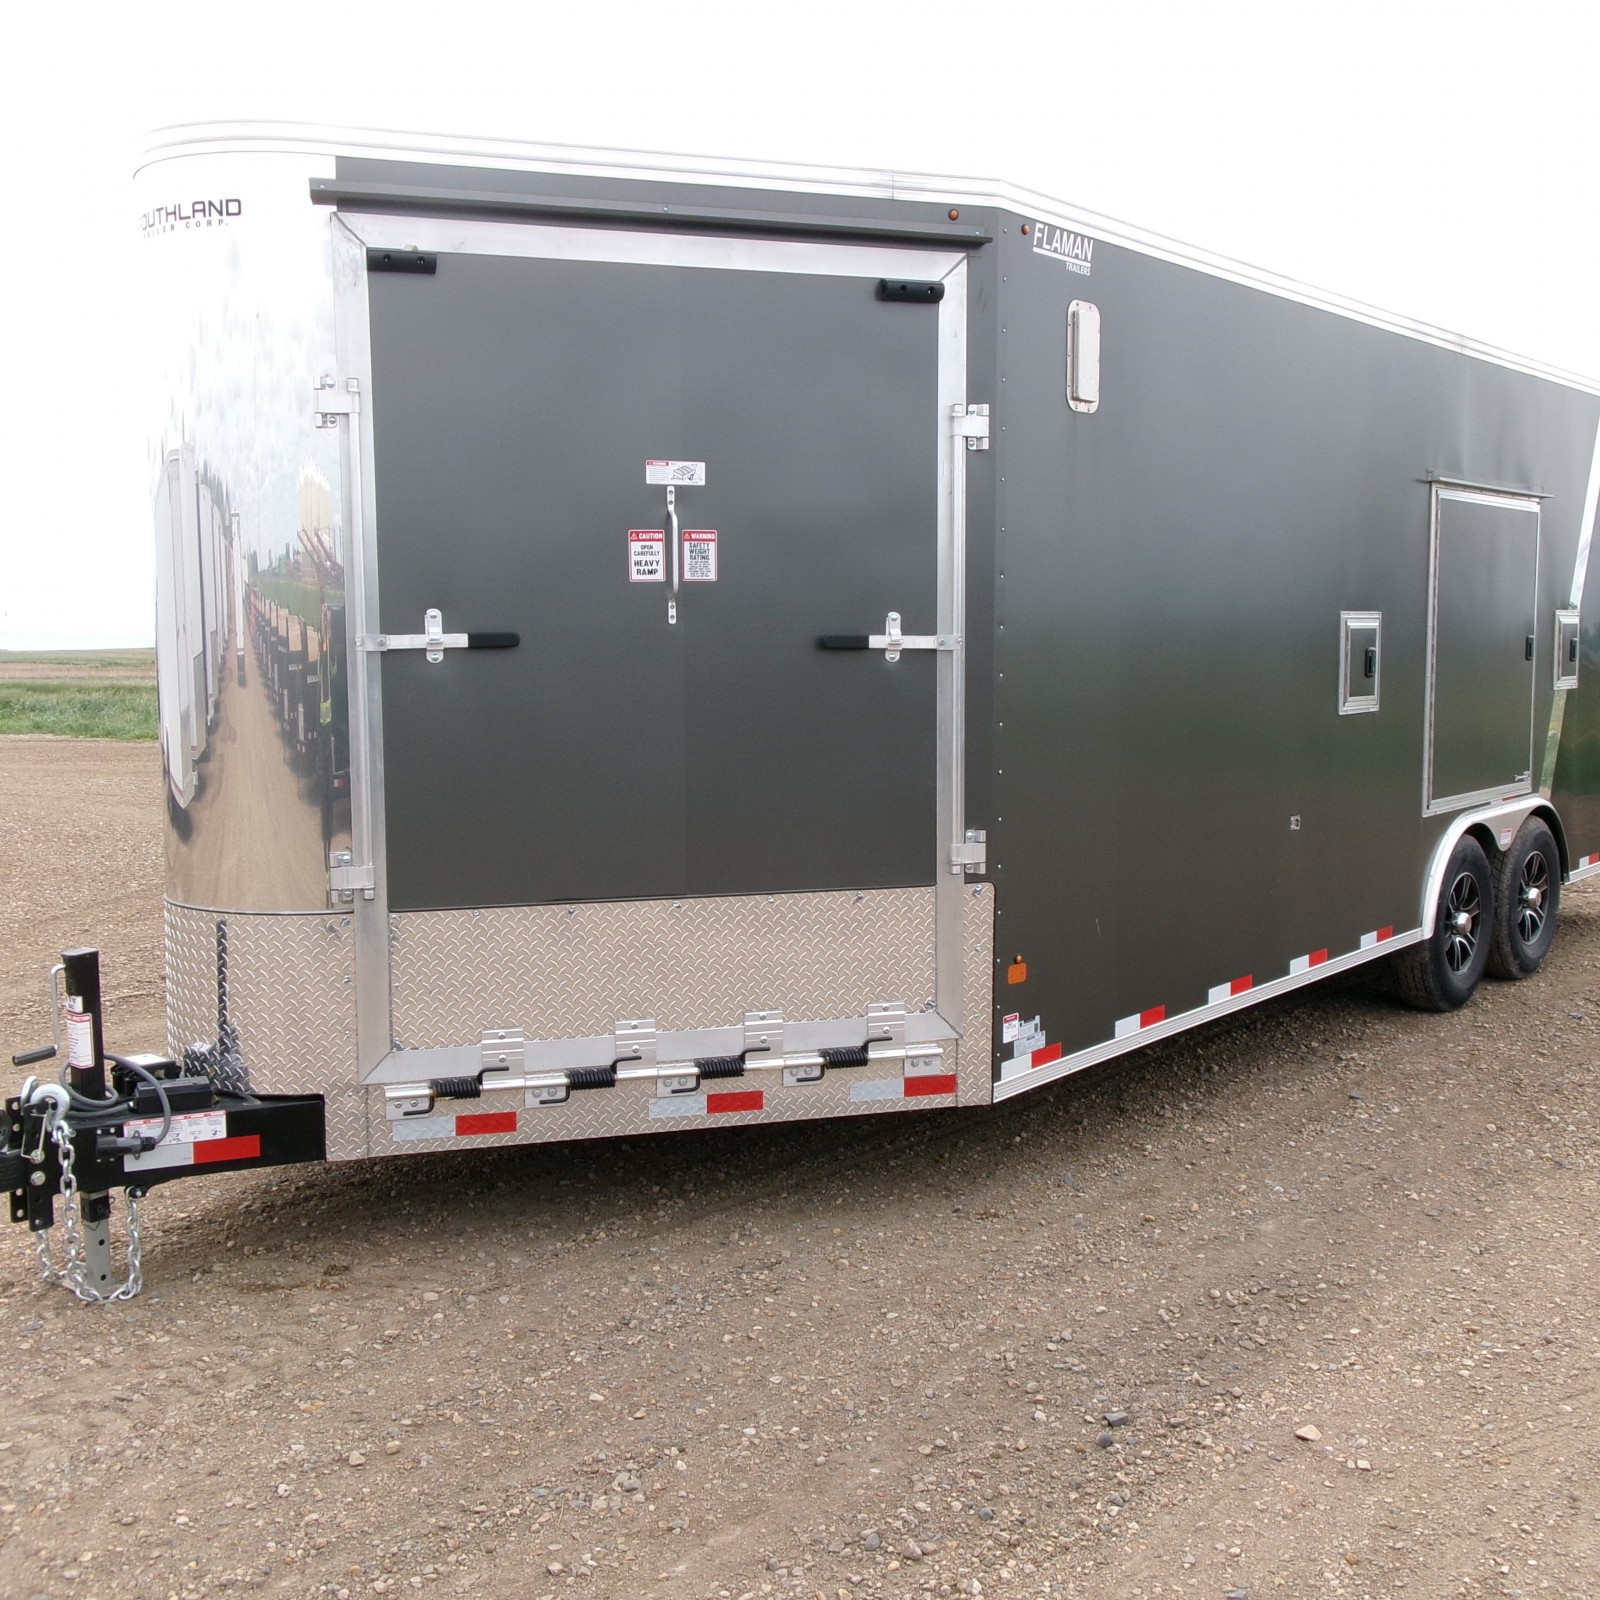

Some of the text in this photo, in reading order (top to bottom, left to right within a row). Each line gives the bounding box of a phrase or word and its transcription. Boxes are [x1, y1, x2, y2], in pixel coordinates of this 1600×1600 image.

[140, 198, 242, 231] OUTHLAND
[185, 219, 228, 229] CORP.
[1033, 222, 1094, 262] FLAMAN
[1065, 261, 1091, 276] TRAILERS
[638, 532, 663, 540] CAUTION
[690, 532, 715, 540] WARNING
[633, 559, 661, 568] HEAVY
[636, 568, 659, 576] RAMP
